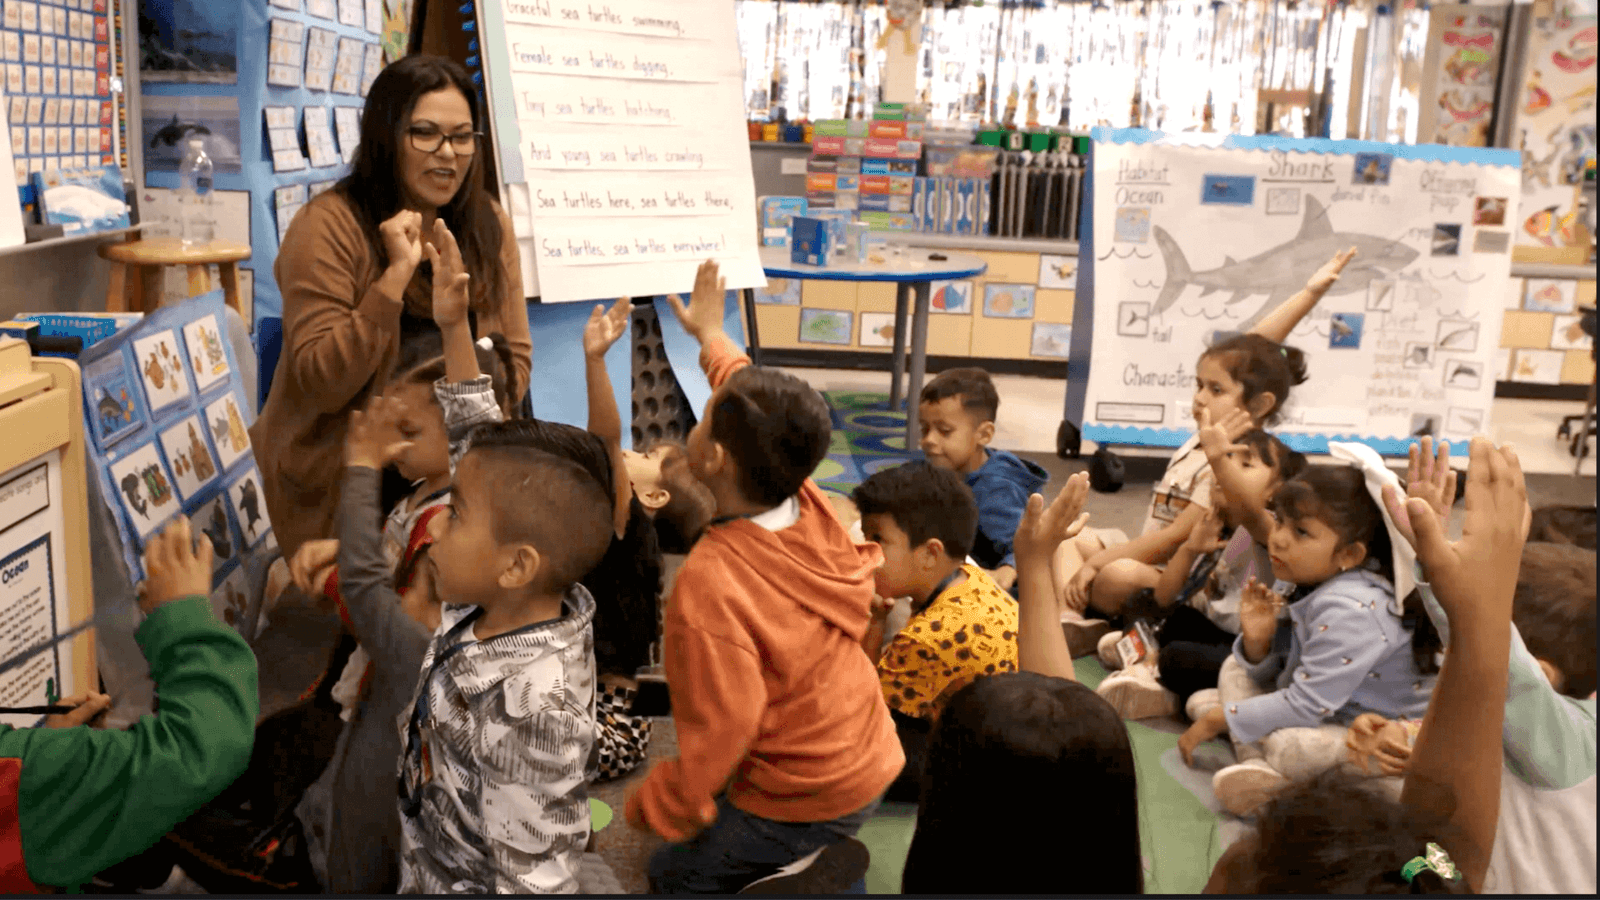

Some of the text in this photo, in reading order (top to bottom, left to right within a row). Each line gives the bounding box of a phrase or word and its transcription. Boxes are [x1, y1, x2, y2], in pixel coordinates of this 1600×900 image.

[561, 8, 580, 20] sea
[588, 4, 622, 24] turtles
[512, 42, 553, 66] Female
[562, 55, 580, 66] sea
[589, 50, 626, 70] turtles
[522, 91, 546, 118] Tiny
[555, 103, 573, 115] sea
[580, 96, 615, 116] turtles
[530, 142, 552, 161] And
[561, 149, 591, 166] young
[600, 150, 617, 162] sea
[624, 146, 658, 162] turtles
[1268, 152, 1334, 179] Shark
[1118, 158, 1170, 182] Habitat
[537, 189, 556, 209] Sea
[563, 190, 602, 210] turtles
[607, 191, 635, 210] here,
[641, 198, 658, 208] sea
[664, 191, 696, 208] turtles
[1116, 186, 1164, 205] Ocean
[542, 238, 562, 258] Sea
[613, 244, 629, 256] sea
[635, 239, 666, 254] turtles
[673, 234, 726, 254] everywhere!
[1152, 324, 1173, 343] tail
[1123, 362, 1197, 387] Character
[2, 559, 29, 584] Ocean
